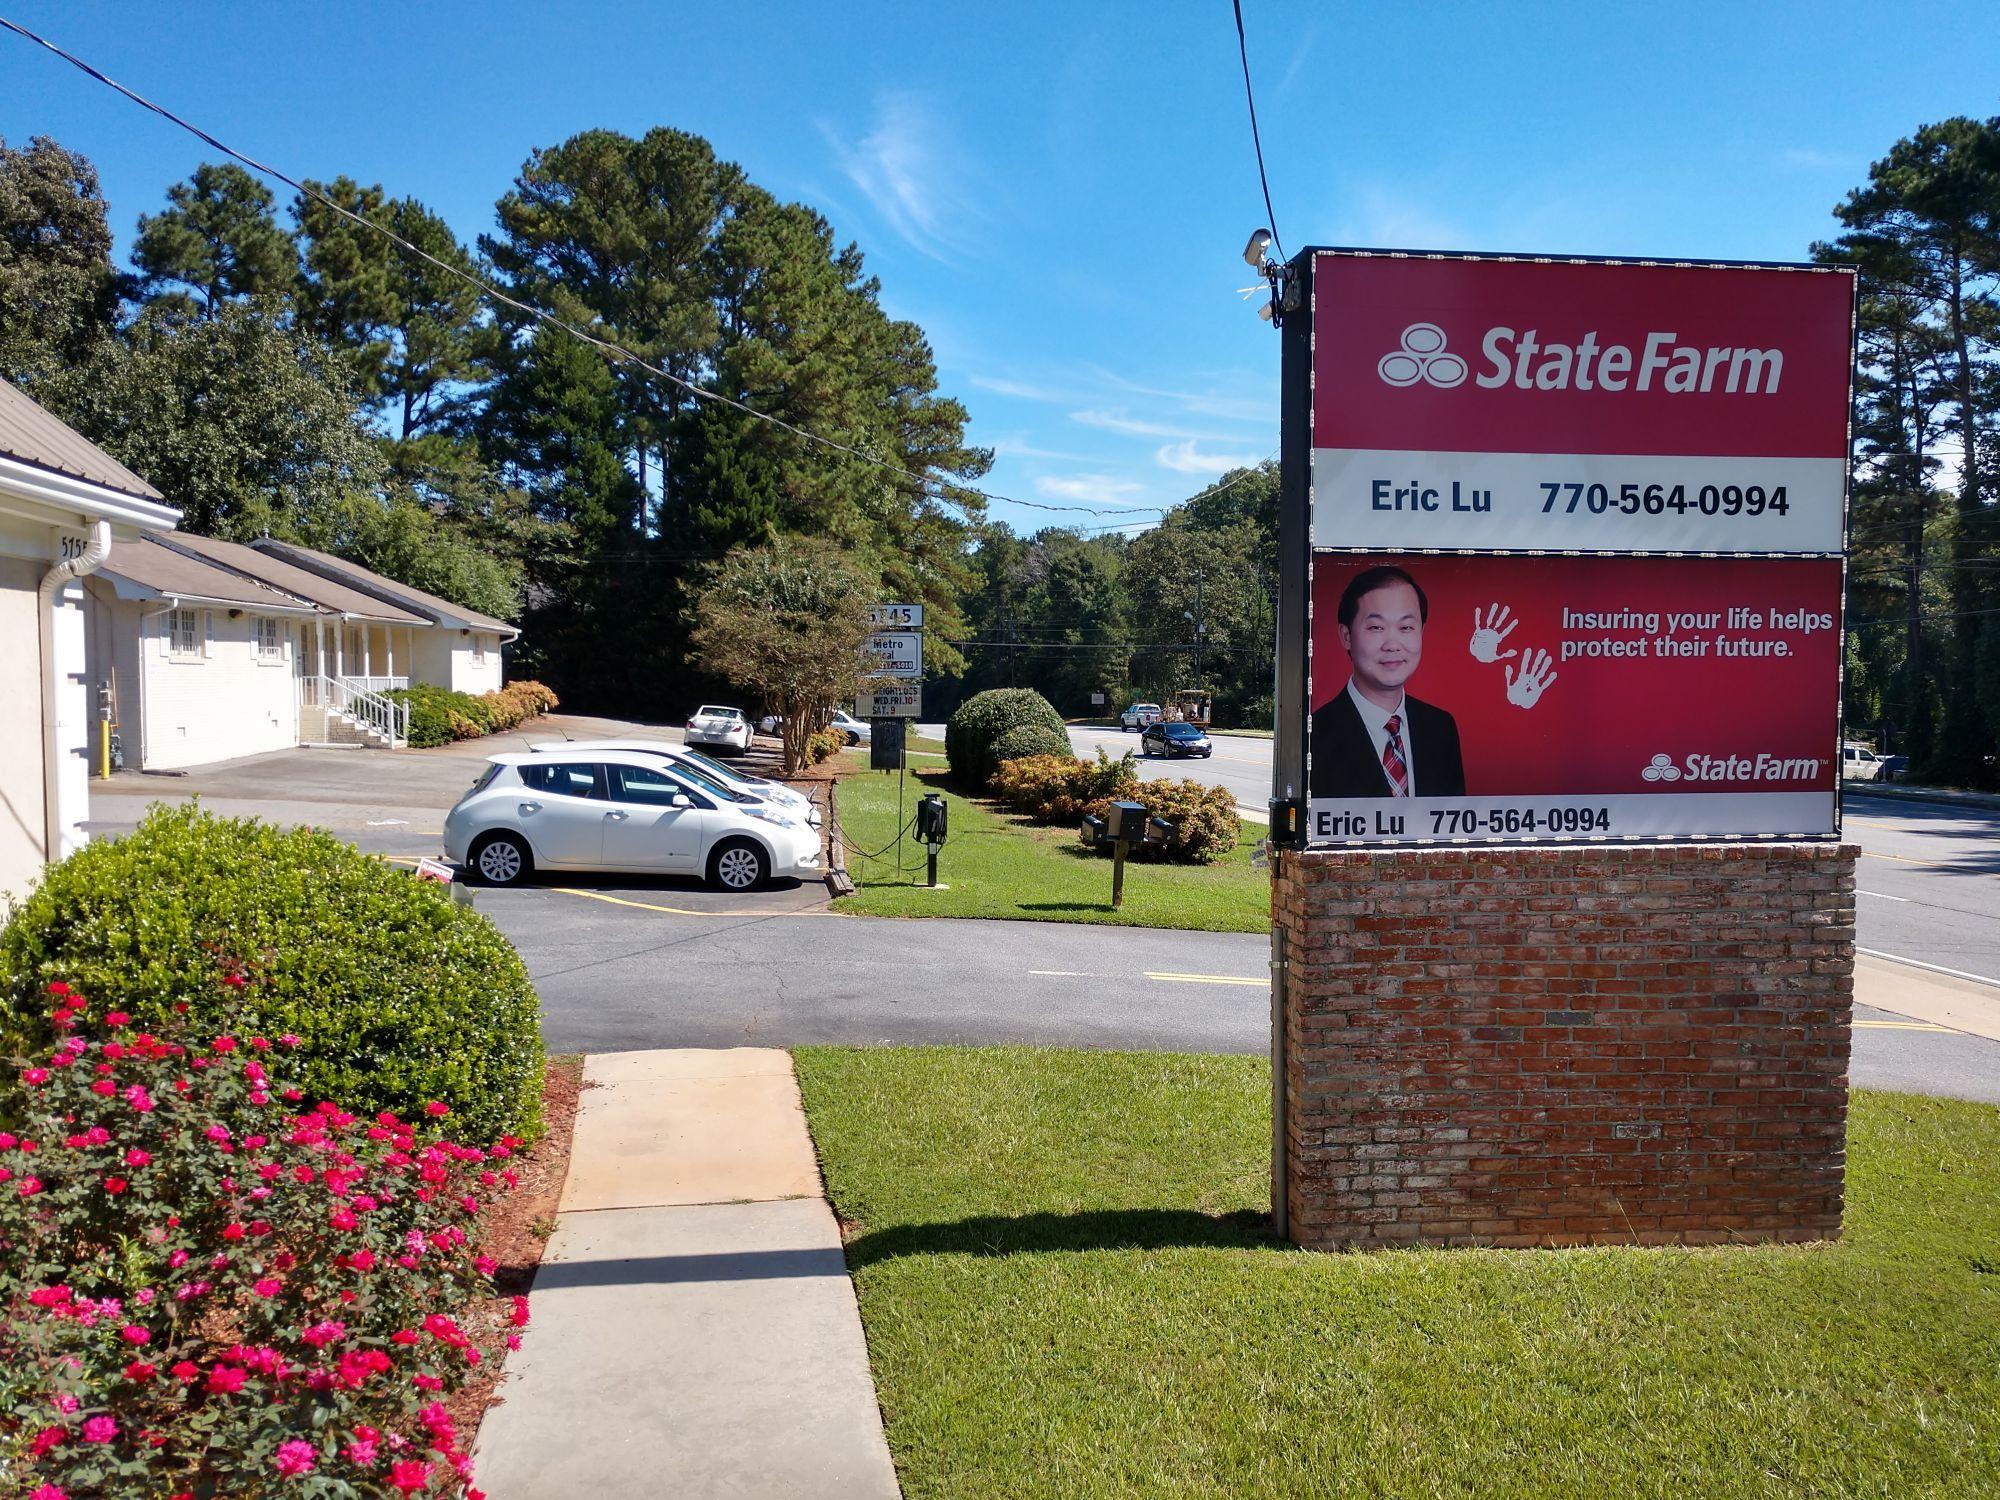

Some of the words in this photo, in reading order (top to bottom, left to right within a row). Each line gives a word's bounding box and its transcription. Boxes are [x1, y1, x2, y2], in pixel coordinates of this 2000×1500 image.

[1371, 479, 1440, 513] Eric
[1452, 480, 1492, 513] Lu
[1539, 482, 1790, 517] 770-564-0994
[1562, 607, 1660, 634] Insuring
[1666, 609, 1721, 634] your
[1727, 607, 1763, 629] life
[1769, 608, 1833, 634] helps
[873, 638, 903, 649] Metro
[1561, 635, 1648, 662] protect
[1653, 635, 1710, 657] their
[1715, 635, 1794, 657] future.
[1316, 810, 1367, 837] Eric
[1375, 809, 1405, 835] Lu
[1429, 805, 1611, 836] 770-564-0994
